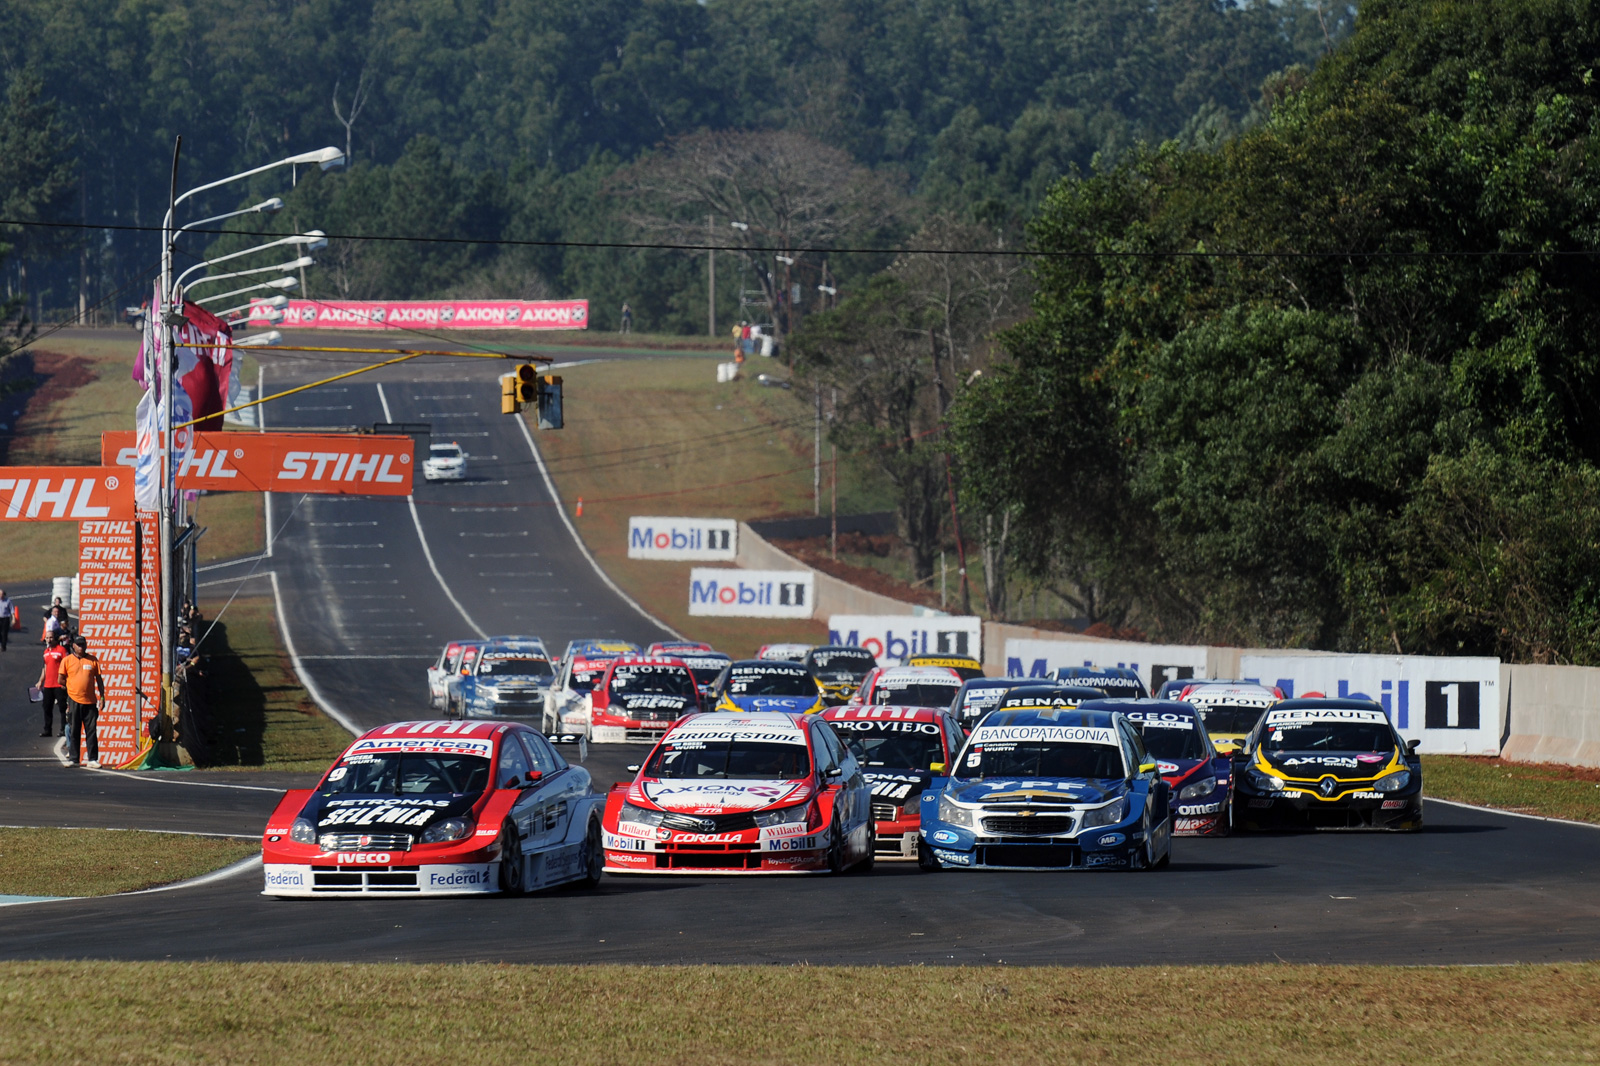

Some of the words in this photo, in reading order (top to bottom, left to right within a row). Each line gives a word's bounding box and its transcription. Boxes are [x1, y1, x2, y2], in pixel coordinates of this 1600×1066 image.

[319, 308, 370, 321] AXION
[388, 308, 438, 322] AXION
[455, 307, 504, 321] AXION
[522, 307, 570, 322] AXION
[277, 451, 404, 483] STIHL
[0, 478, 110, 518] TIHL
[81, 521, 133, 534] STIHL
[632, 527, 701, 550] Mobil
[81, 547, 133, 560] STIHL
[81, 573, 133, 586] STIHL
[692, 580, 772, 605] Mobil
[81, 599, 133, 612] STIHL
[81, 624, 133, 637] STIHL
[829, 629, 928, 659] Mobil
[85, 648, 133, 661] TIHL
[614, 665, 688, 675] CROTTA
[731, 667, 808, 676] RENAULT
[730, 683, 748, 693] 21
[752, 698, 795, 708] CKC
[1006, 698, 1082, 707] RENAU
[1187, 697, 1268, 706] DuPon
[1438, 683, 1462, 727] 1
[835, 705, 922, 719] FIAT
[1126, 712, 1194, 723] GEOT
[1273, 711, 1380, 720] RENAULT
[382, 720, 494, 735] FIAT
[668, 731, 800, 742] BRIDGESTONE
[980, 727, 1111, 742] BANCOPATAGONIA
[1271, 730, 1284, 742] 4
[356, 739, 488, 751] American
[401, 747, 484, 755] brokers
[663, 751, 682, 764] 7
[966, 752, 981, 767] 5
[1284, 756, 1359, 766] AXION
[328, 767, 347, 782] 9
[655, 785, 746, 796] AXION
[982, 781, 1087, 790] YPF
[1352, 791, 1385, 799] FRAM
[326, 799, 450, 808] PETRONAS
[318, 805, 436, 827] SELENIA
[620, 823, 651, 837] Willard
[766, 824, 804, 837] Willard
[607, 836, 633, 850] Mobil
[673, 833, 743, 843] COROLLA
[769, 839, 805, 850] Mobil
[337, 853, 391, 864] IVECO
[267, 872, 304, 886] Federal
[430, 871, 481, 885] Federal
